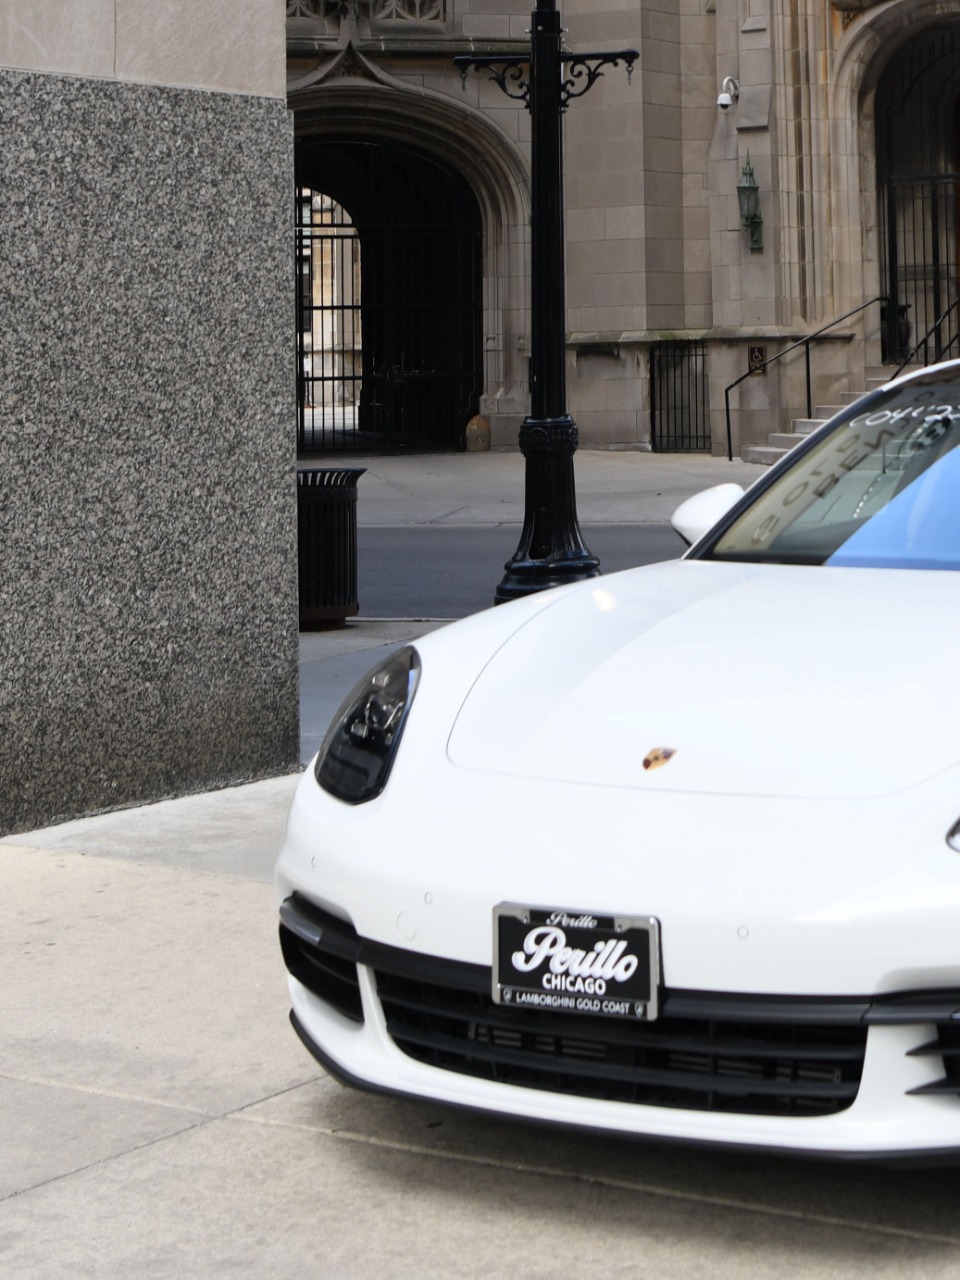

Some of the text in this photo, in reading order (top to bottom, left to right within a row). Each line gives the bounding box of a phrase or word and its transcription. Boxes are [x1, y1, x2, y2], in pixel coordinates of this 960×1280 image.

[546, 911, 598, 929] Perillo
[511, 926, 638, 982] Perillo
[542, 973, 607, 995] CHICAGO
[516, 992, 630, 1014] LAMBORGHINI GOLD COAST
